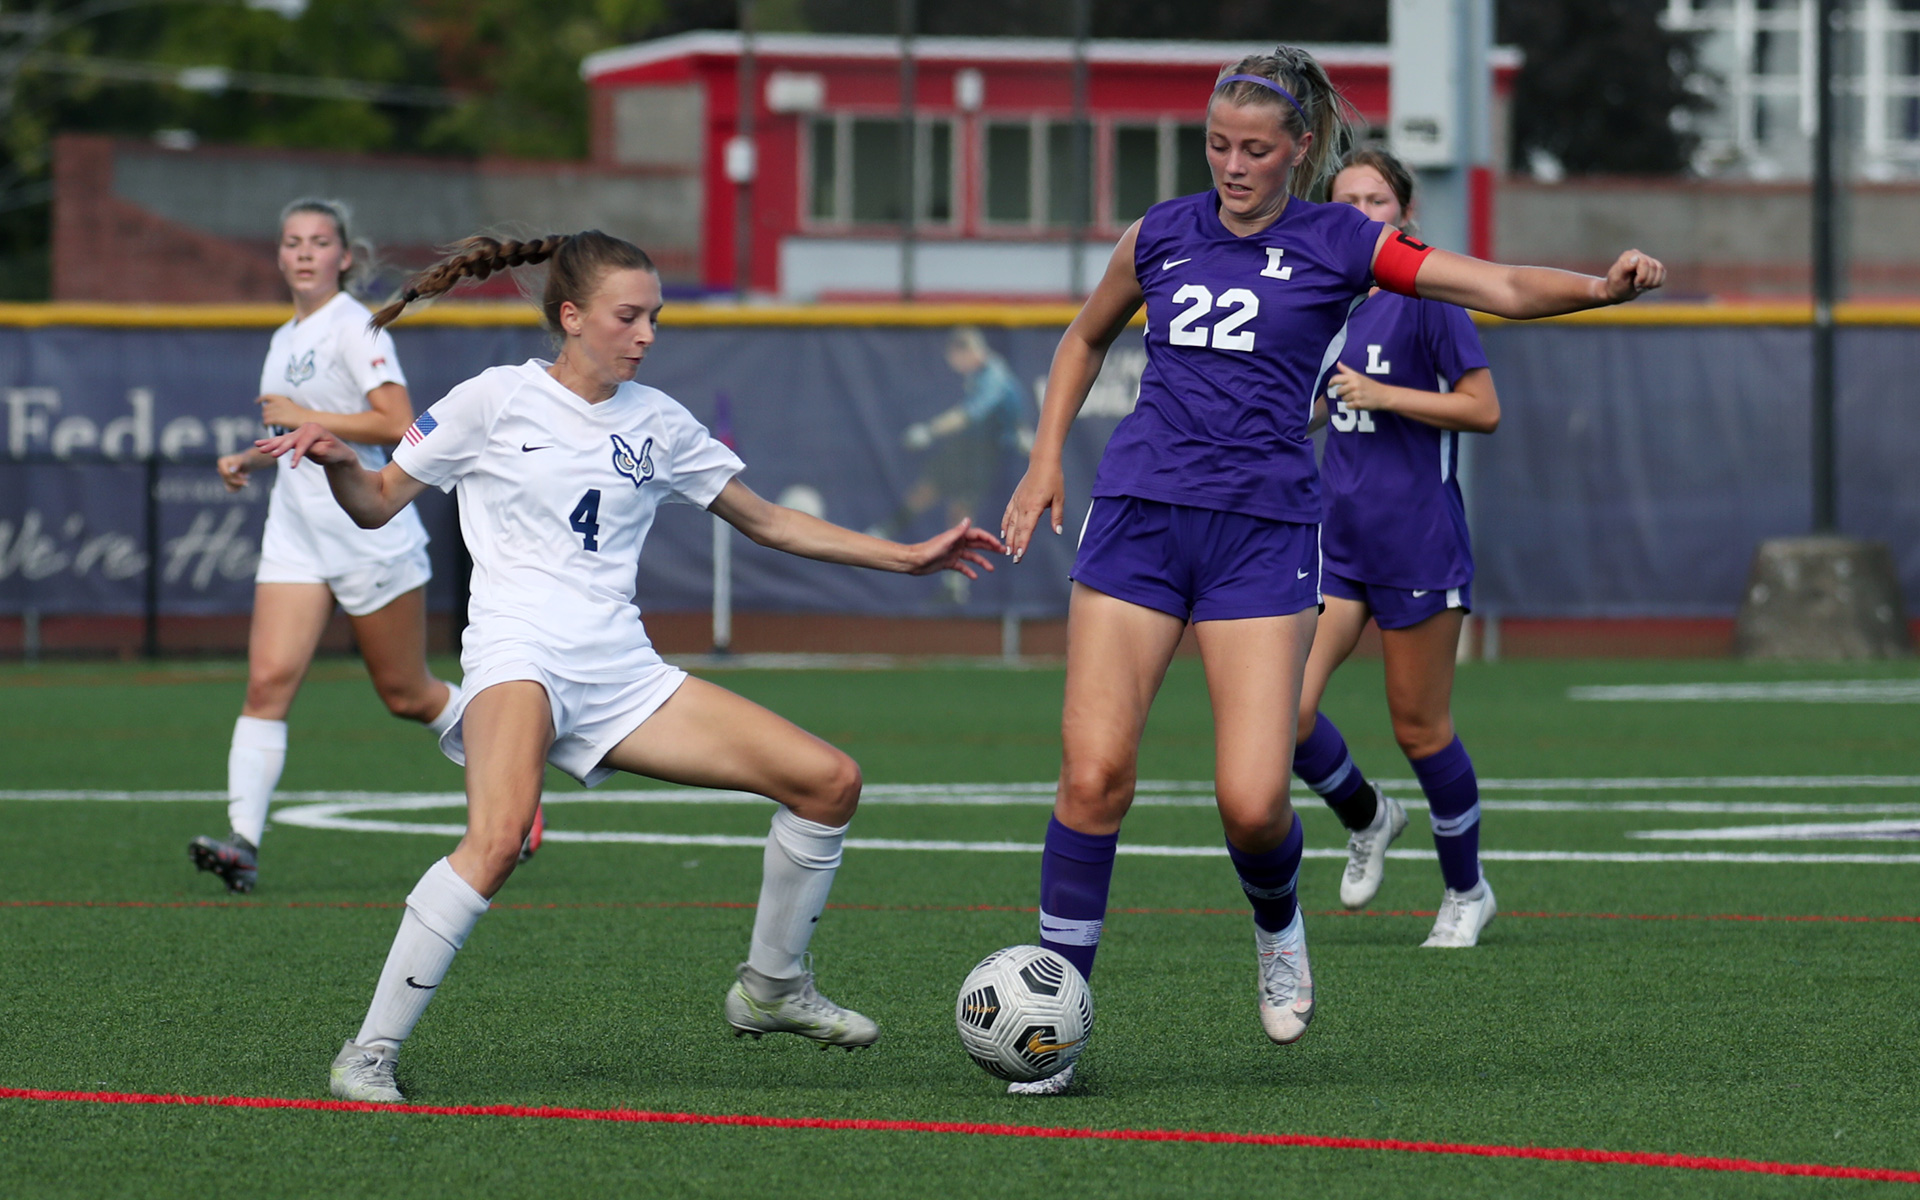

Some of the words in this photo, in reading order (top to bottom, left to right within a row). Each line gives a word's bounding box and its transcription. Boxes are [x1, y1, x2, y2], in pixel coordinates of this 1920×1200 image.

[1260, 247, 1293, 281] L
[1168, 284, 1260, 352] 22
[1365, 344, 1390, 375] L
[3, 386, 268, 462] Feder
[568, 488, 602, 552] 4
